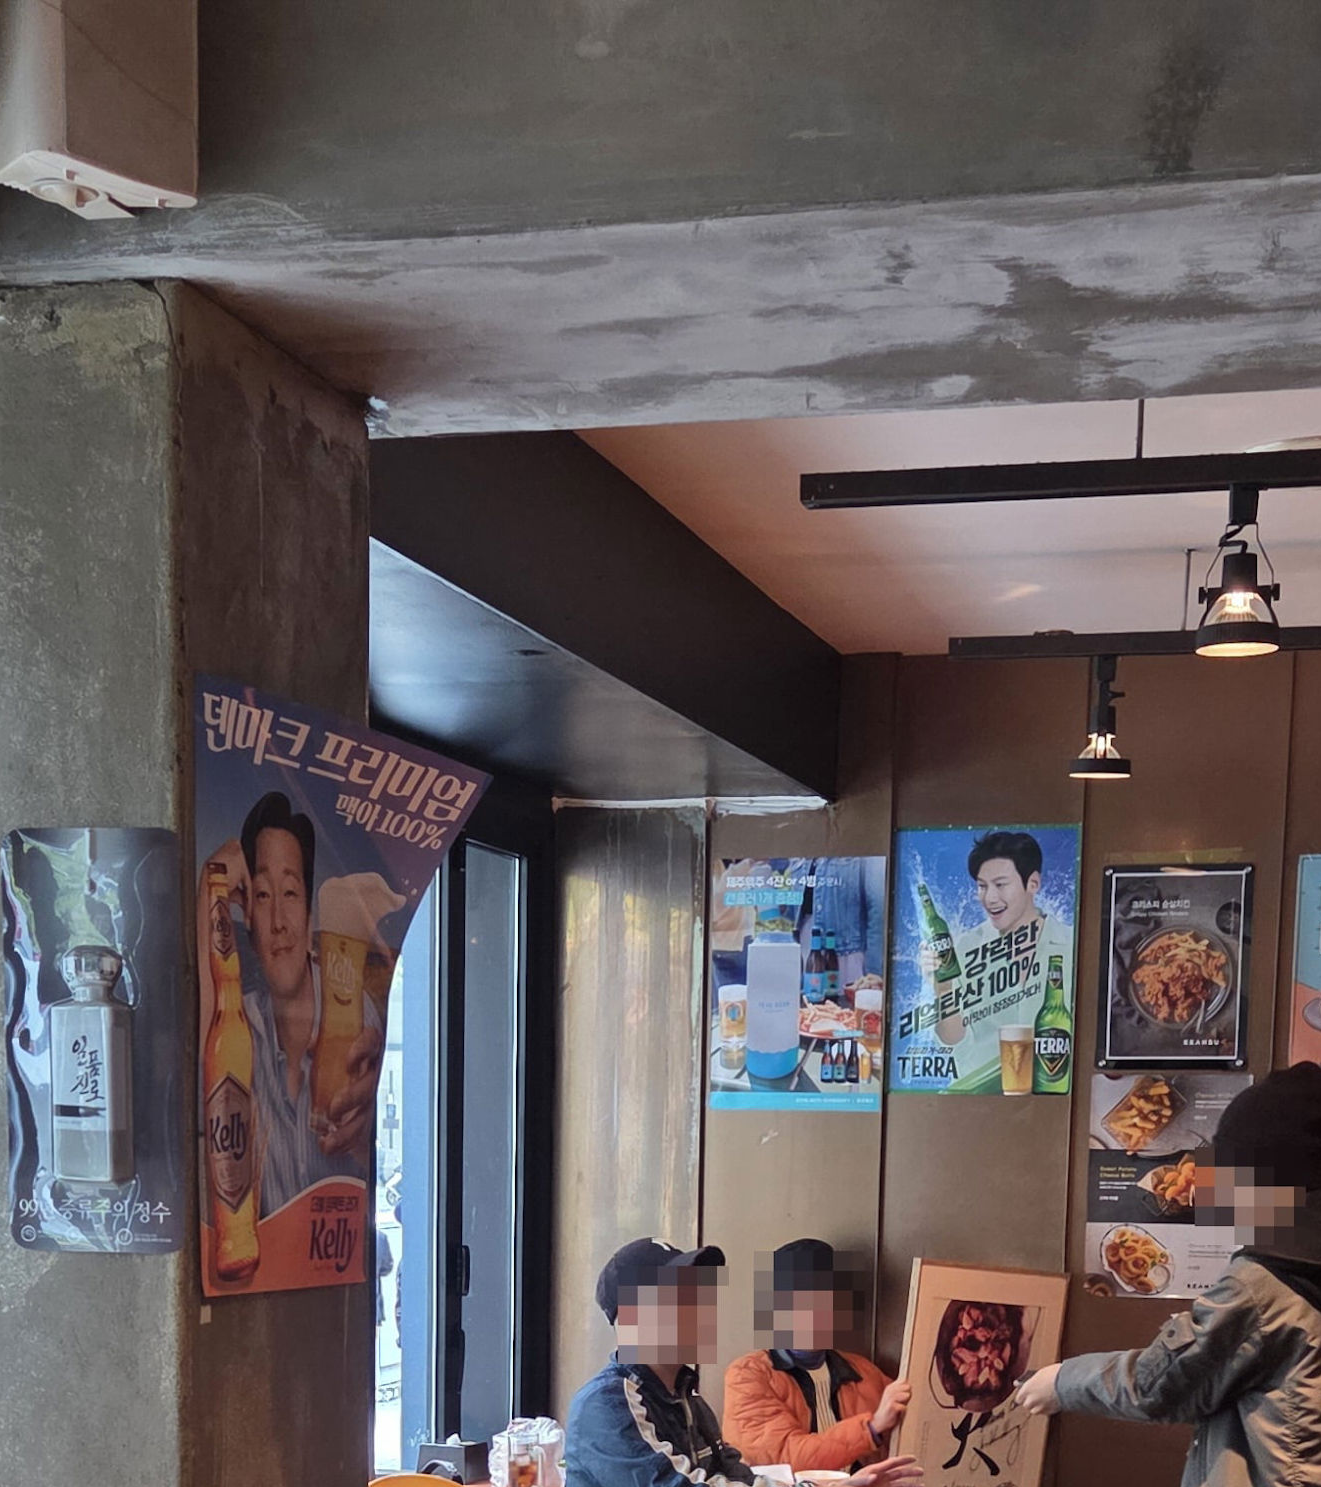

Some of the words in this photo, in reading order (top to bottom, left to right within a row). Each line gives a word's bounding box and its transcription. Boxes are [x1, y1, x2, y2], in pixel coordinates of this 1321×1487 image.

[203, 692, 310, 770] 덴마크
[307, 731, 478, 822] 프리미엄
[964, 919, 1039, 979] 강력한
[899, 978, 984, 1040] 리얼탄산
[988, 950, 1040, 997] 100%
[897, 1056, 958, 1079] TERRA
[1033, 1037, 1070, 1054] TERRA
[209, 1113, 249, 1161] Kelly
[134, 1201, 172, 1225] 정수
[309, 1218, 358, 1273] Kelly
